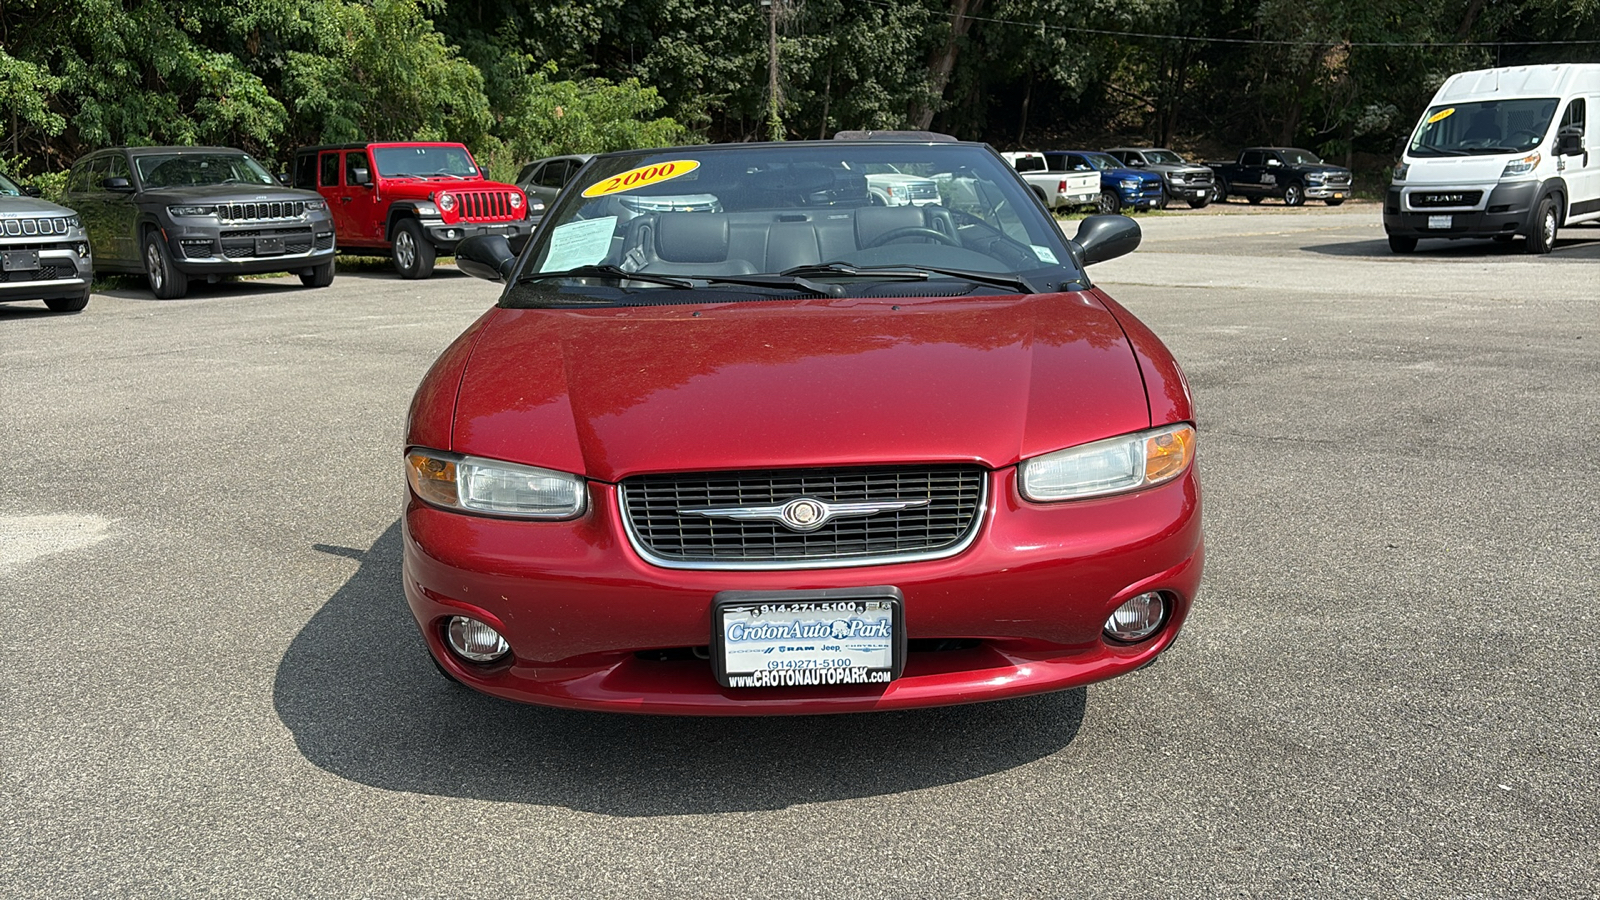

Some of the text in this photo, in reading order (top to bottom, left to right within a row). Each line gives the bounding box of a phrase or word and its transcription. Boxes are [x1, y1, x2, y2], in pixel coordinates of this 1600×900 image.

[604, 163, 674, 191] 2000
[849, 619, 891, 638] Park
[821, 644, 841, 652] Jeep
[768, 658, 851, 669] (914)271-5100
